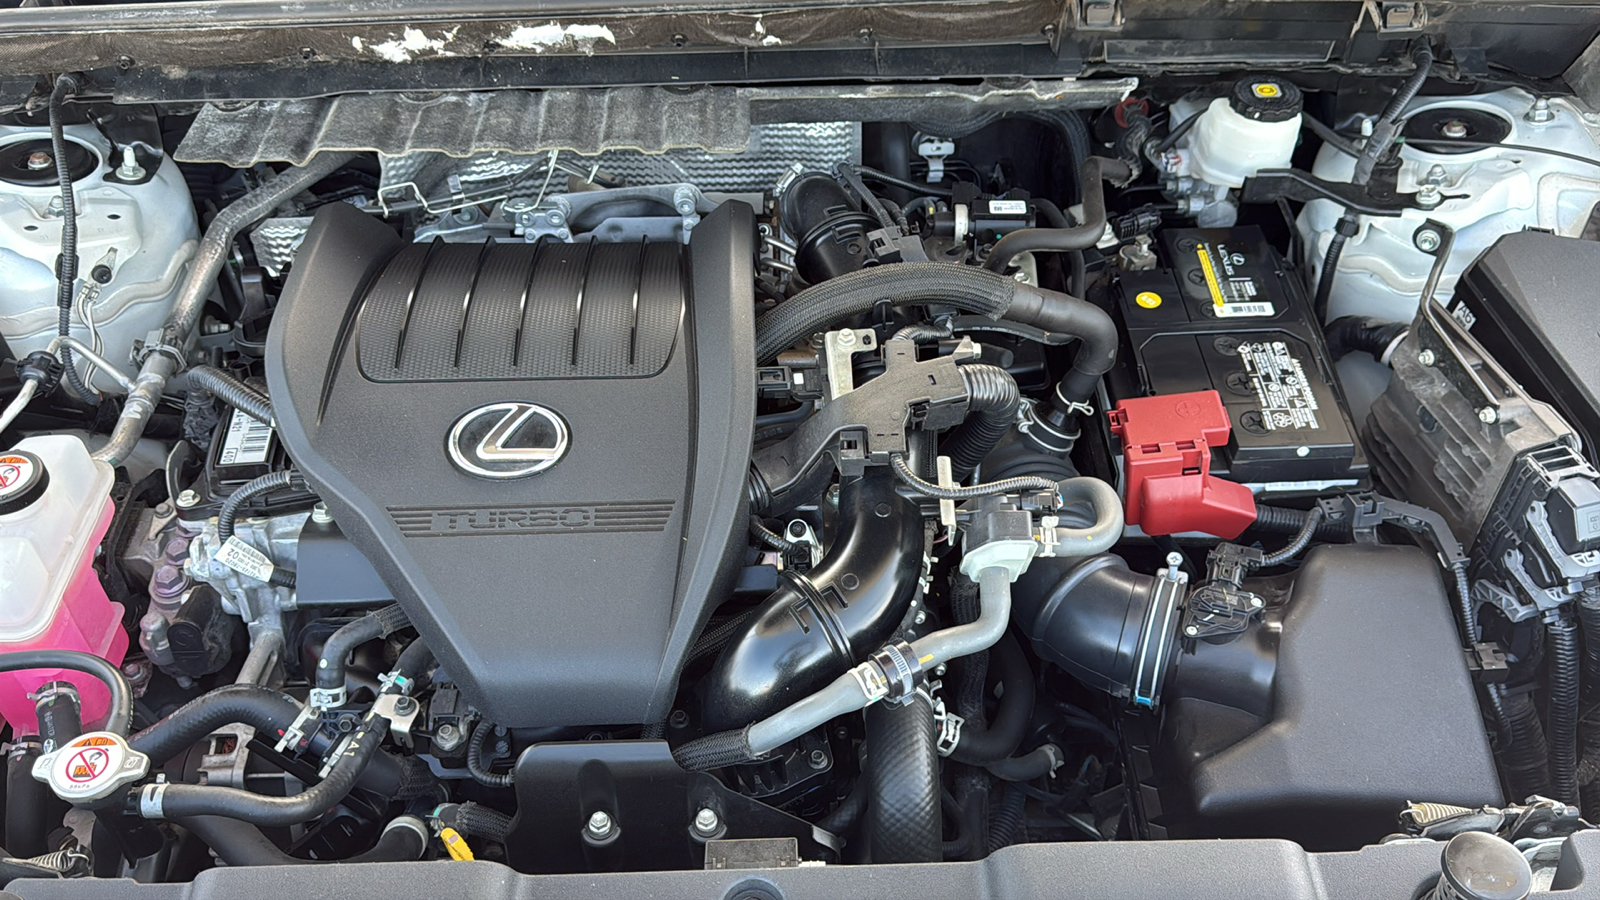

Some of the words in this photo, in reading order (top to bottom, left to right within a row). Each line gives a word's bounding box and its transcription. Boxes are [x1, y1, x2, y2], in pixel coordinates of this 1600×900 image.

[1217, 244, 1235, 276] LEXUS
[1458, 305, 1472, 322] A6
[231, 410, 244, 433] A-N21
[222, 450, 235, 463] 400
[437, 507, 592, 531] TURBO
[226, 547, 241, 561] 02
